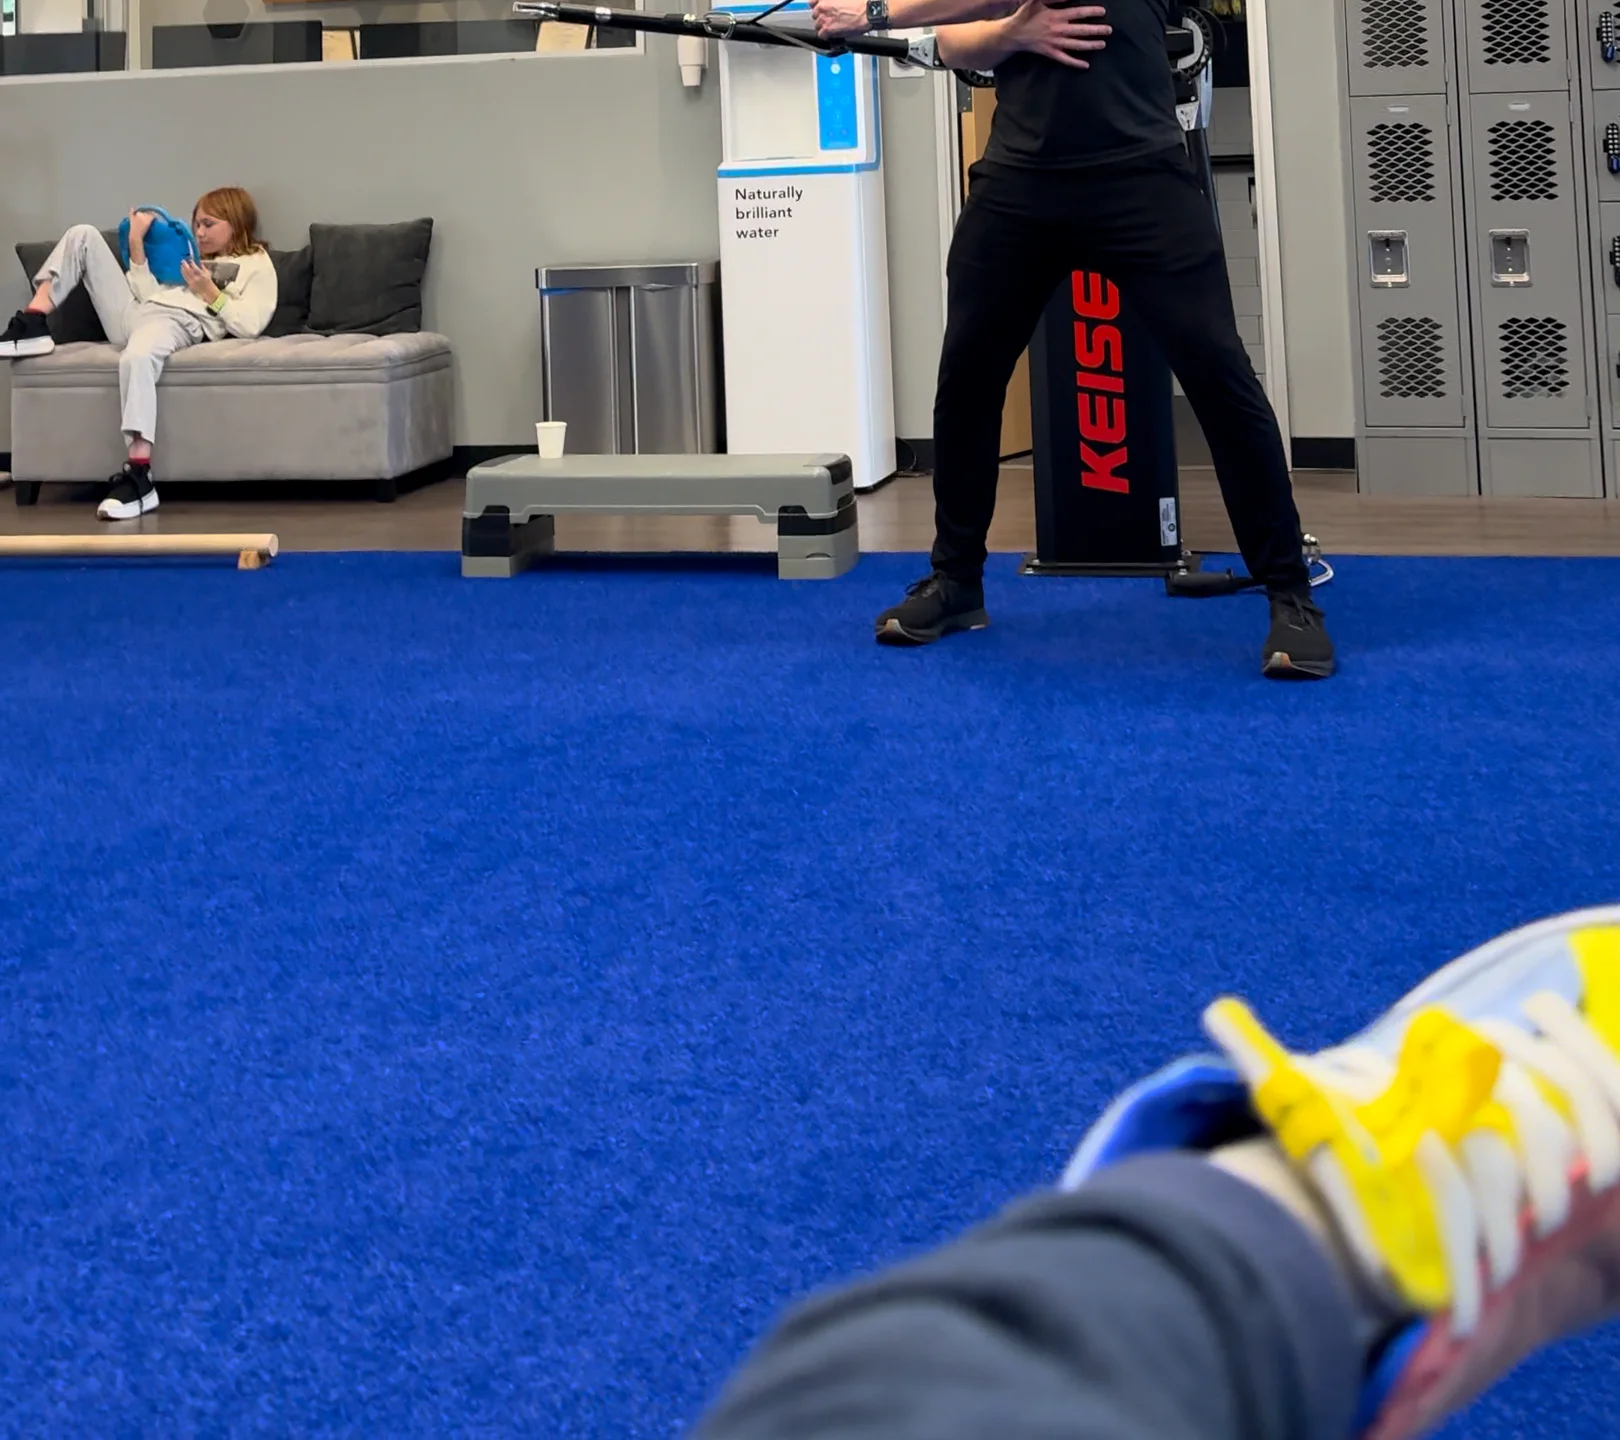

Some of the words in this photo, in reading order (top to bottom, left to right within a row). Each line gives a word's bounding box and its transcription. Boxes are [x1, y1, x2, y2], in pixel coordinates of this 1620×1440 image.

[735, 186, 803, 202] Naturally
[735, 206, 793, 220] brilliant
[736, 227, 780, 239] water
